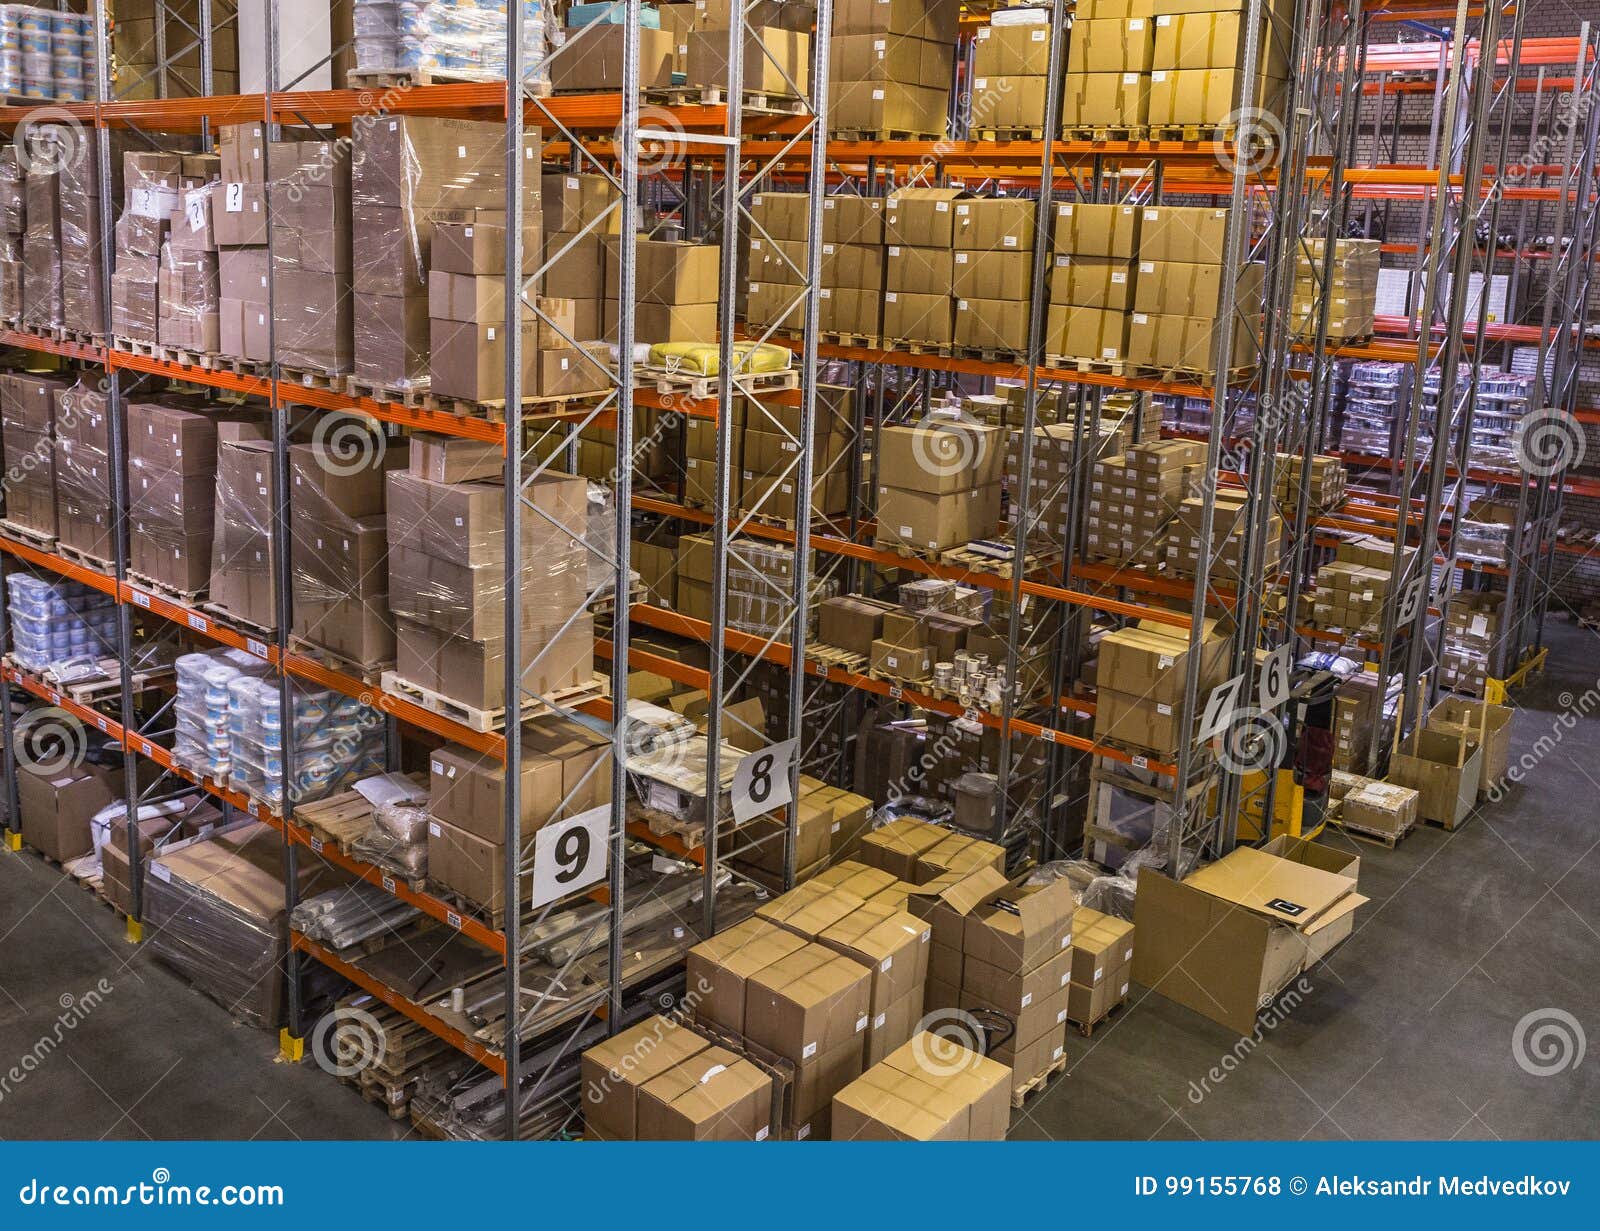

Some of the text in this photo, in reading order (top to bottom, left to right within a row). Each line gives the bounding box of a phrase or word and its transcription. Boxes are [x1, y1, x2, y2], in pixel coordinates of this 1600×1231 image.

[231, 183, 240, 207] ?
[1404, 585, 1420, 617] 5
[1437, 567, 1451, 598] 4
[1267, 656, 1280, 699] 6
[1209, 684, 1235, 729] 7
[748, 753, 775, 804] 8
[554, 825, 591, 884] 9
